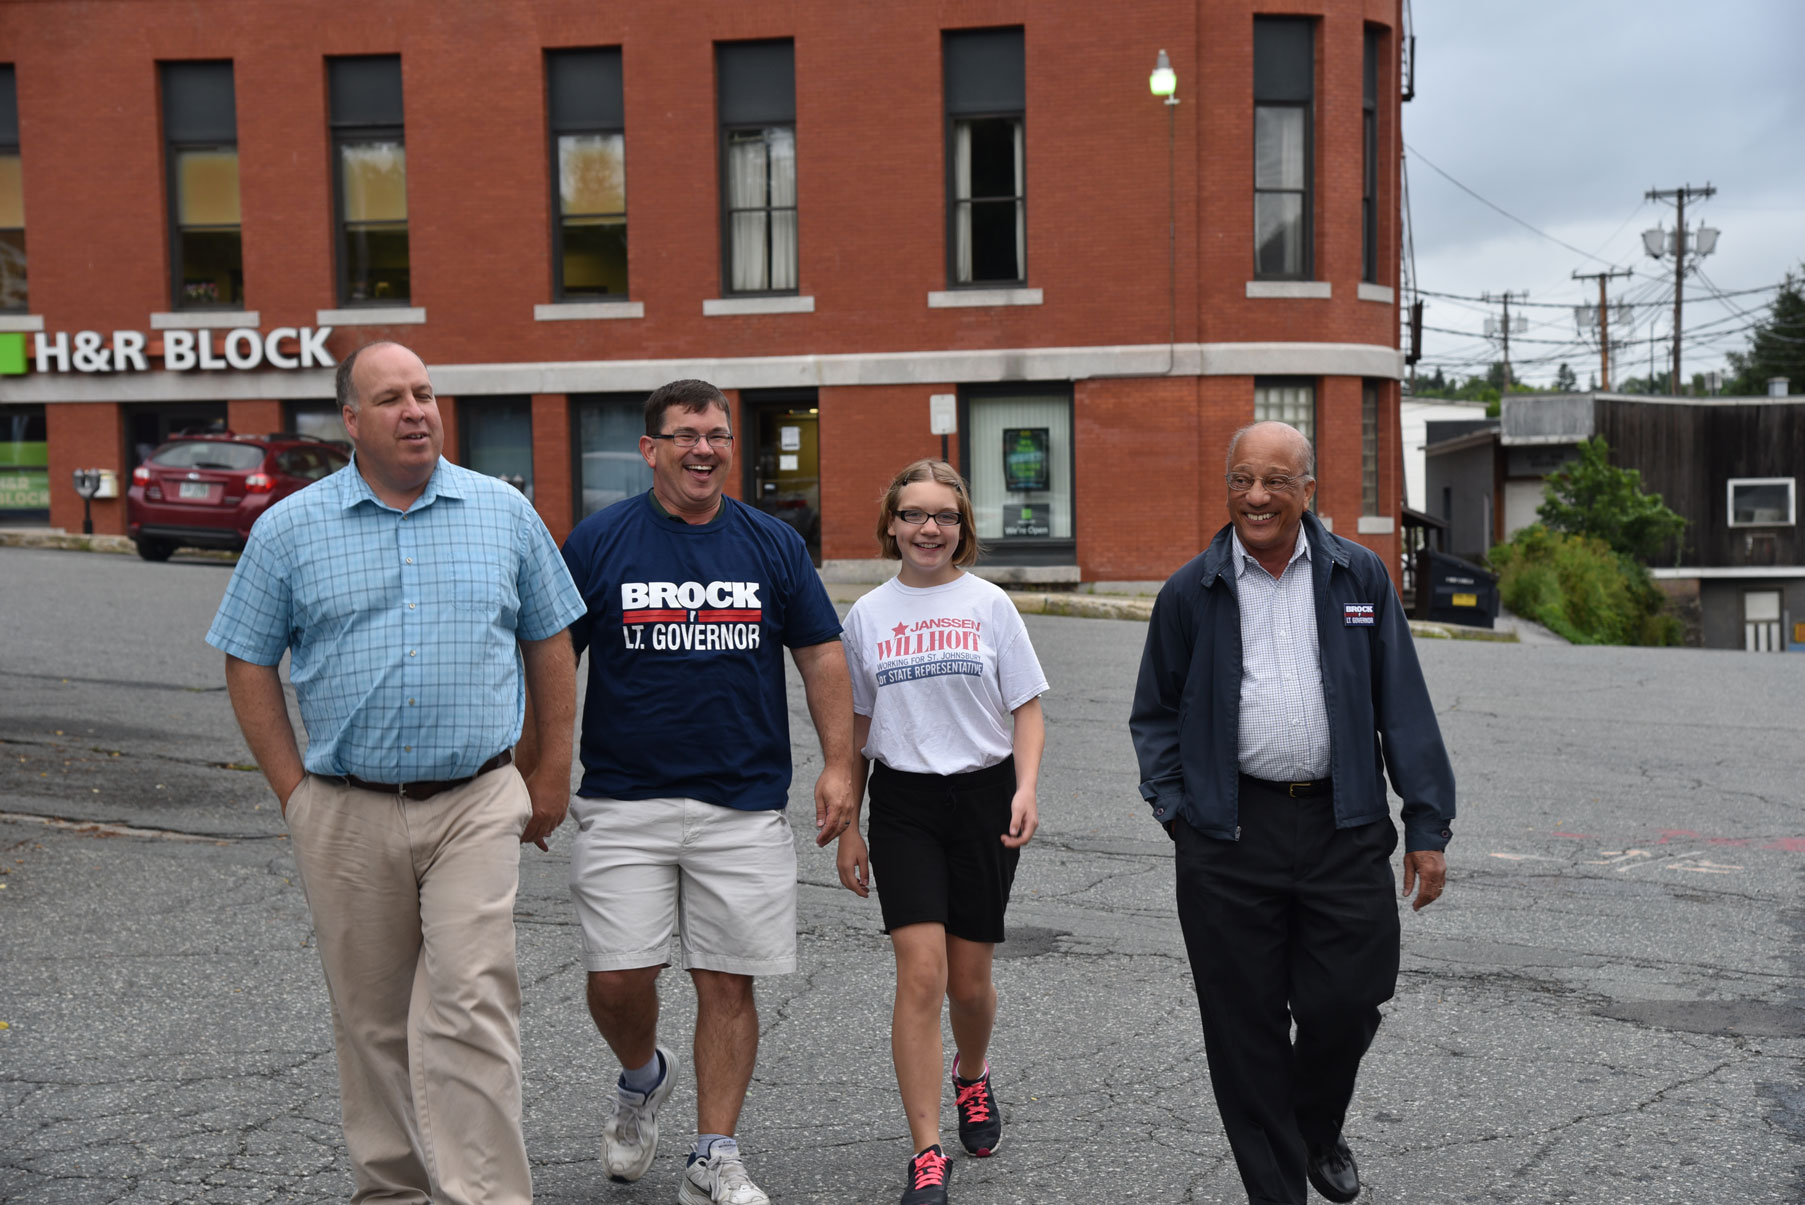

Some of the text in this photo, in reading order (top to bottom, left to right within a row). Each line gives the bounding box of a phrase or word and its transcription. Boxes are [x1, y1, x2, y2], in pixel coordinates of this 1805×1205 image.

[34, 326, 337, 373] H&R BLOCK
[621, 581, 762, 610] BROCK
[1345, 605, 1373, 613] BROCK
[910, 617, 981, 632] JANSSEN
[622, 623, 760, 650] LT. GOVERNOR
[877, 658, 909, 671] WORKING
[911, 655, 925, 665] FOR
[941, 651, 981, 661] JOHNSBURY
[888, 668, 913, 683] STATE
[915, 661, 982, 678] REPRESENTATIVE
